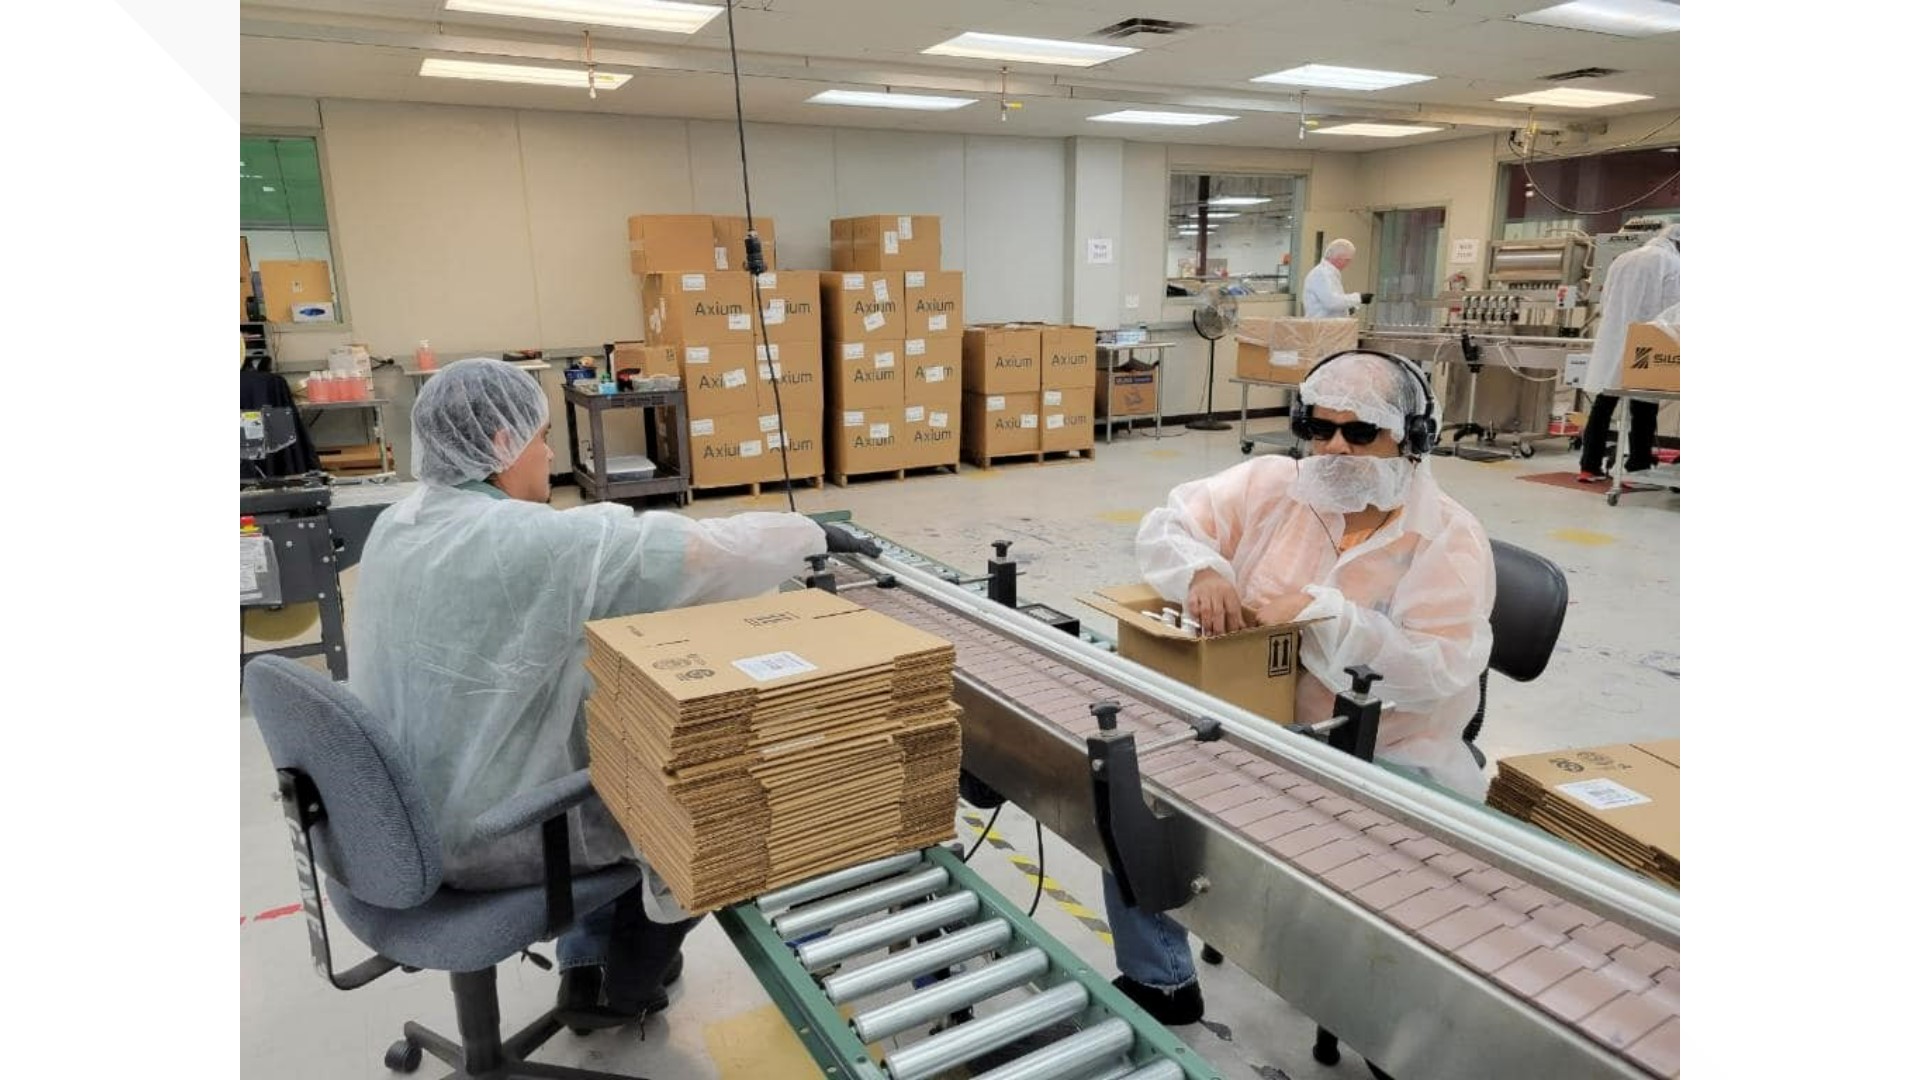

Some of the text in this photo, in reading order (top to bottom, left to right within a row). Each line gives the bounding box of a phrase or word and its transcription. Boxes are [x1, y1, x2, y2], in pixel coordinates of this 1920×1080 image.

[695, 301, 742, 316] Axium
[767, 302, 811, 315] ium
[854, 300, 896, 314] Axium
[916, 299, 954, 312] Axium
[995, 355, 1032, 368] Axium
[1052, 353, 1088, 366] Axium
[854, 369, 895, 382] Axium
[995, 416, 1021, 430] Axiu
[854, 435, 895, 448] Axium
[914, 429, 951, 441] Axium
[704, 443, 740, 459] Axiu
